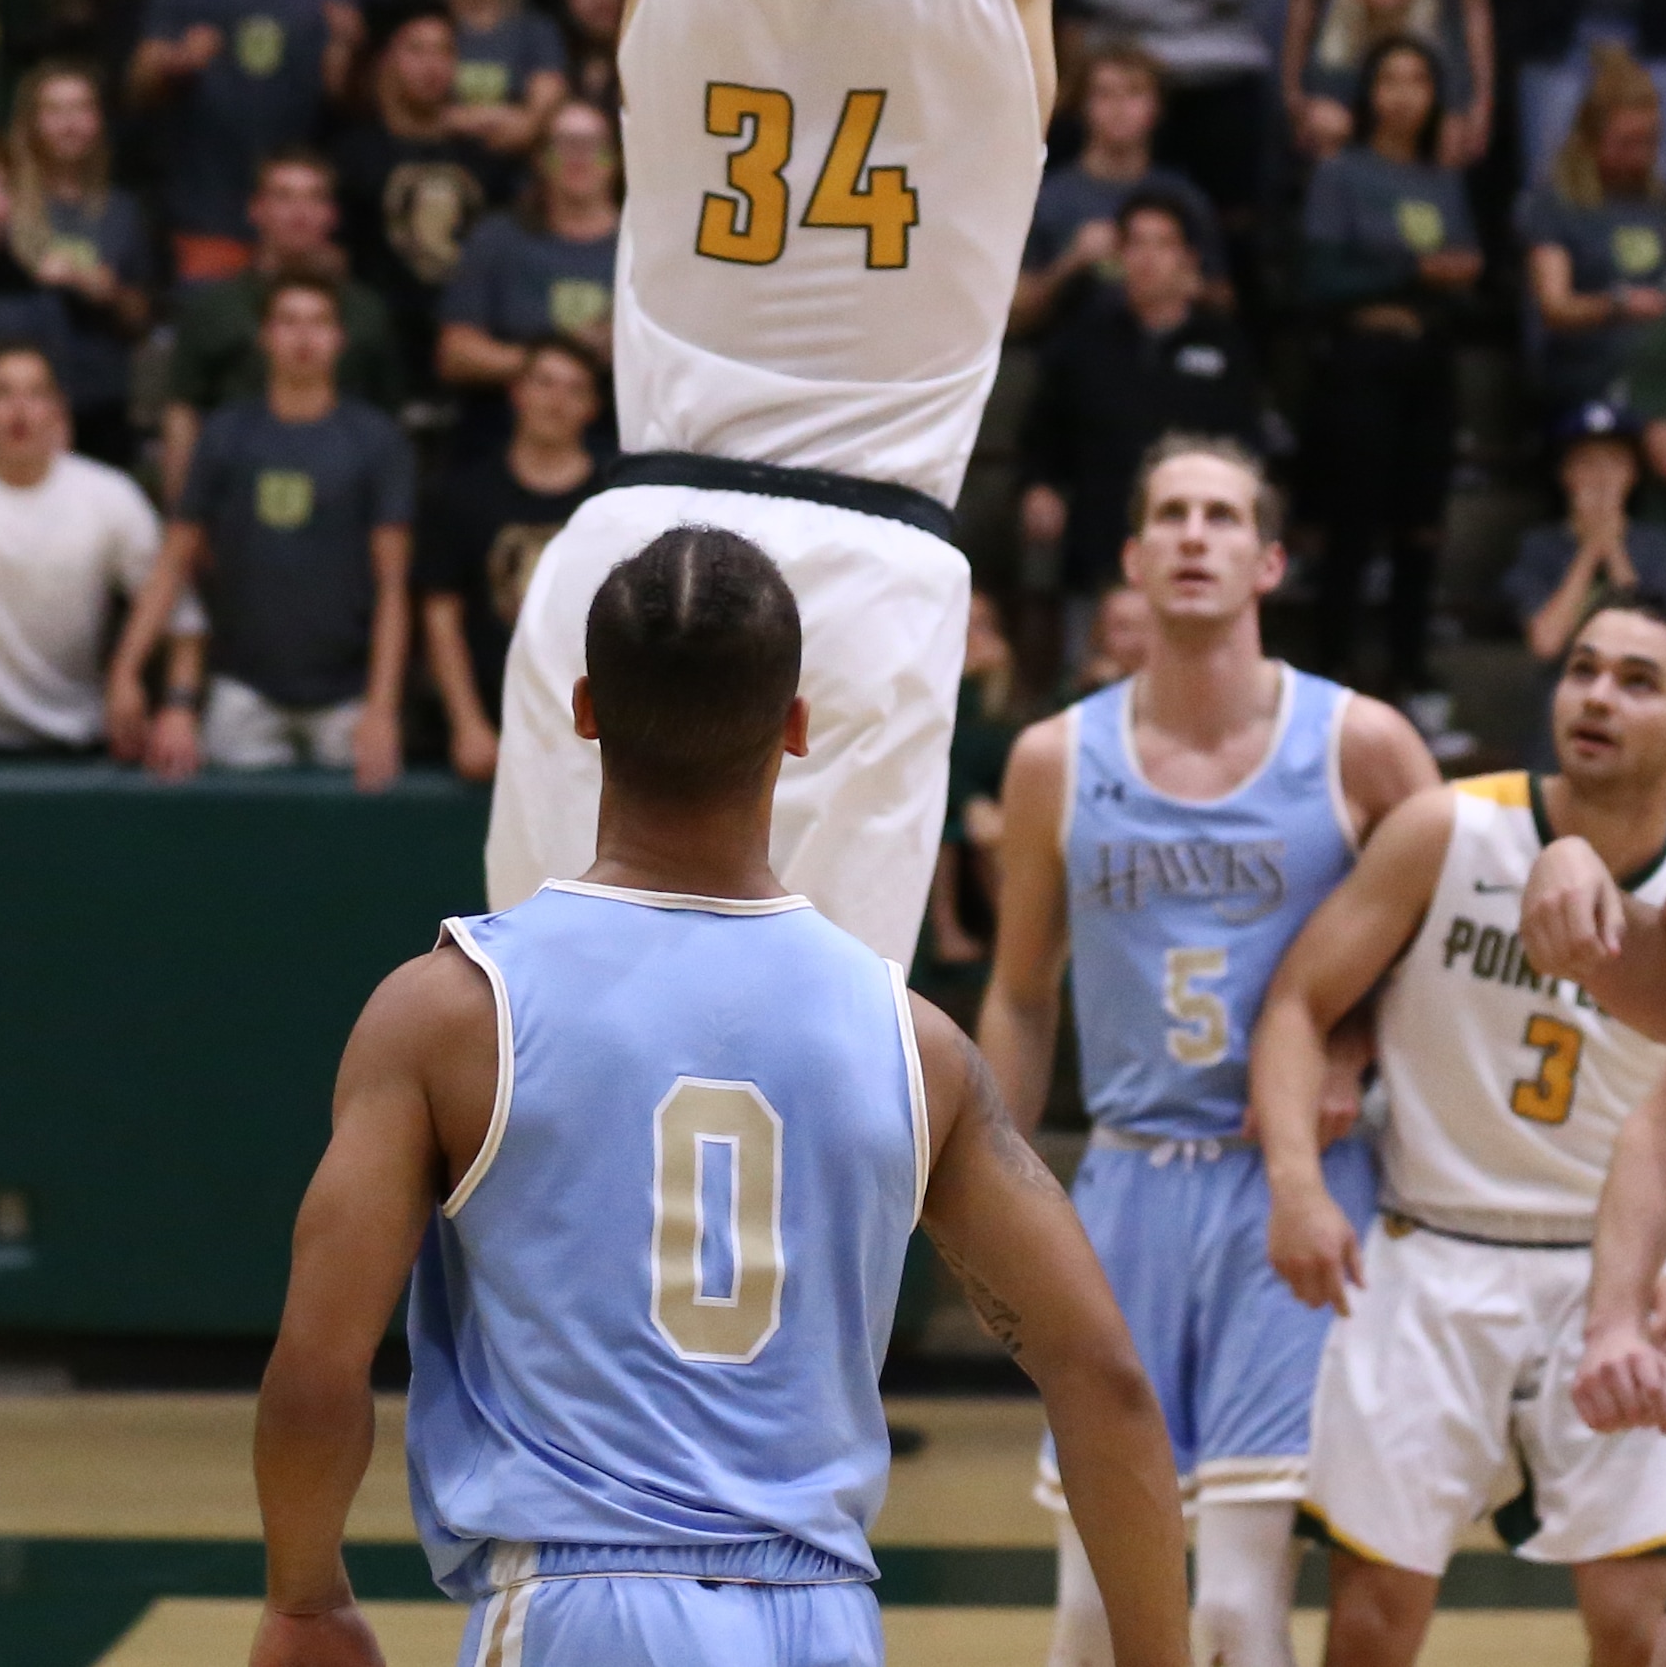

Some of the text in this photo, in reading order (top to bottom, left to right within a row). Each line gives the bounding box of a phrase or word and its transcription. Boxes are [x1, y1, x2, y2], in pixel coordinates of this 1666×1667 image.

[695, 81, 919, 269] 34
[1093, 839, 1285, 926] HAWKS
[1163, 947, 1229, 1066] 5
[1443, 914, 1561, 999] POI
[1509, 1013, 1580, 1125] 3
[649, 1076, 785, 1365] 0
